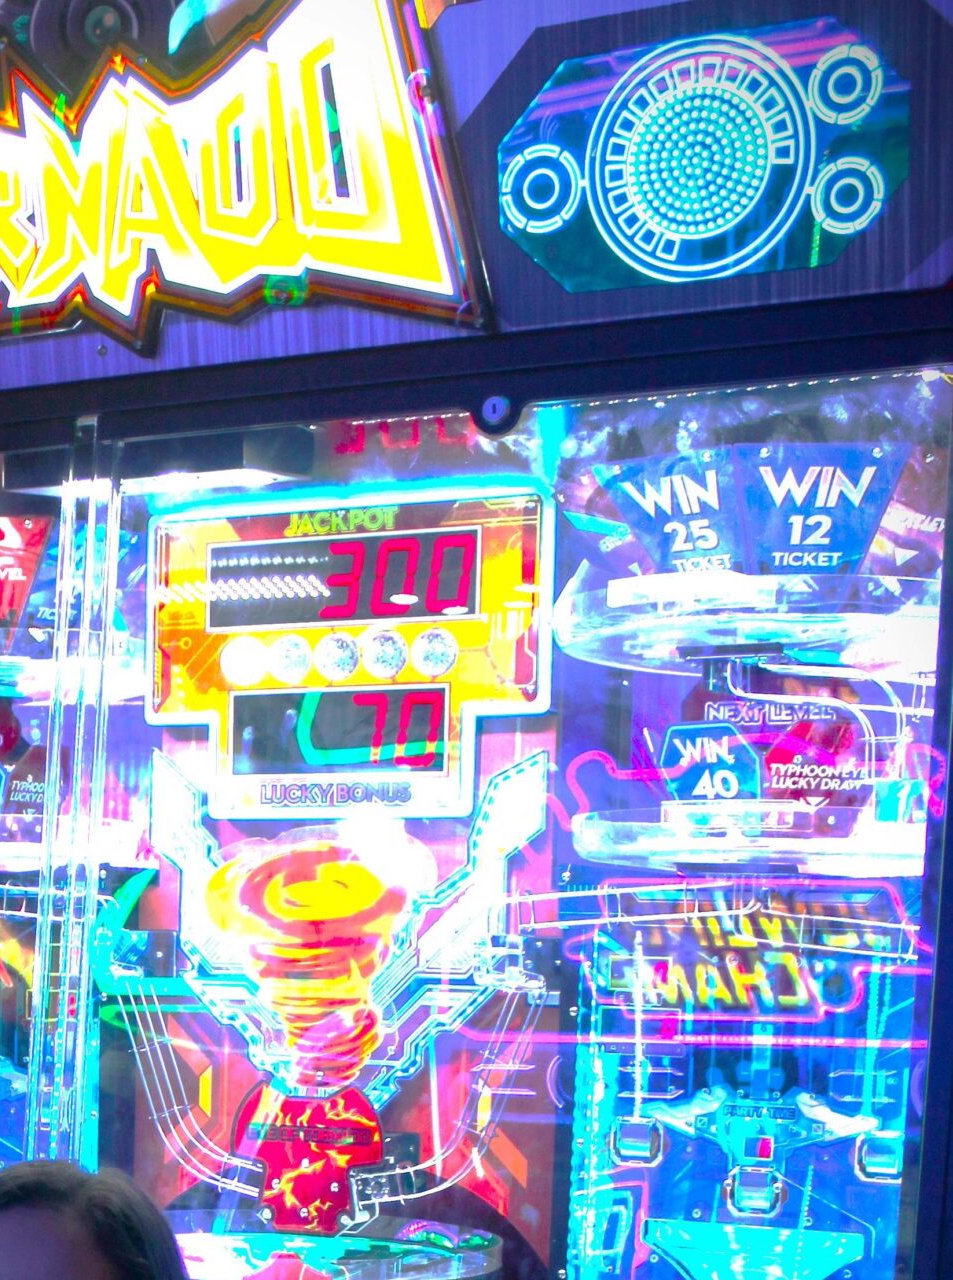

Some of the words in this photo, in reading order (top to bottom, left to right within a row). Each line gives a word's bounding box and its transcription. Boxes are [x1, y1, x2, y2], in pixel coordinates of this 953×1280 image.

[622, 469, 721, 519] WIN
[758, 465, 877, 509] WIN
[285, 506, 399, 537] JACKPOT
[663, 518, 719, 552] 25
[787, 514, 833, 546] 12
[771, 552, 844, 567] TICKET
[318, 533, 477, 619] 300
[352, 691, 444, 767] 70
[673, 736, 731, 764] WIN
[692, 768, 740, 800] 40
[770, 763, 842, 778] TYPHOON
[772, 776, 820, 790] LUCKY
[820, 777, 863, 791] DRAW
[10, 791, 37, 803] LUCKY
[11, 780, 45, 792] TYPHOO
[261, 783, 333, 805] LUCKY
[335, 782, 412, 805] BONUS
[723, 1104, 764, 1118] PARTY
[767, 1106, 797, 1121] TIME
